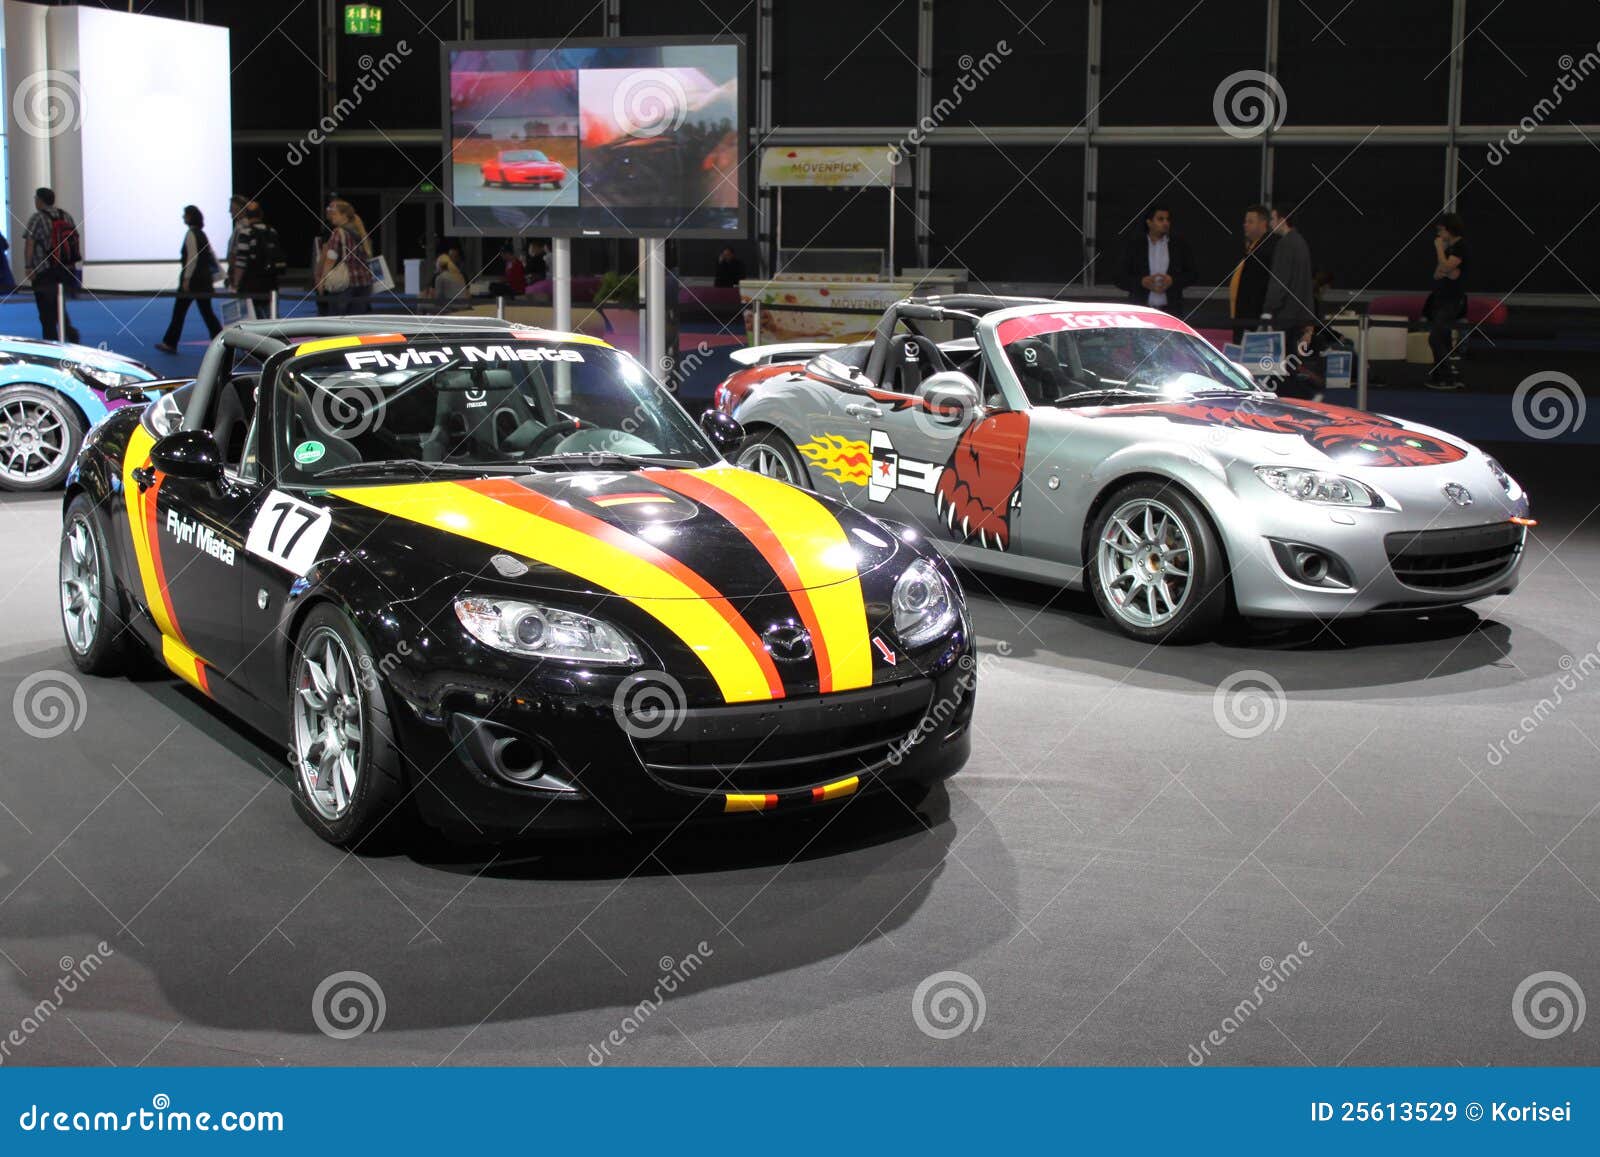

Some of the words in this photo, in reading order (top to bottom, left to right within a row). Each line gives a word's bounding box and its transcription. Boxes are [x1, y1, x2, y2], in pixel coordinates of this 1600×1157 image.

[344, 346, 454, 371] Flyin'
[460, 345, 586, 363] Miata
[306, 442, 314, 452] 4
[166, 508, 197, 545] Flyin'
[196, 523, 236, 567] Miata
[267, 501, 321, 559] 17
